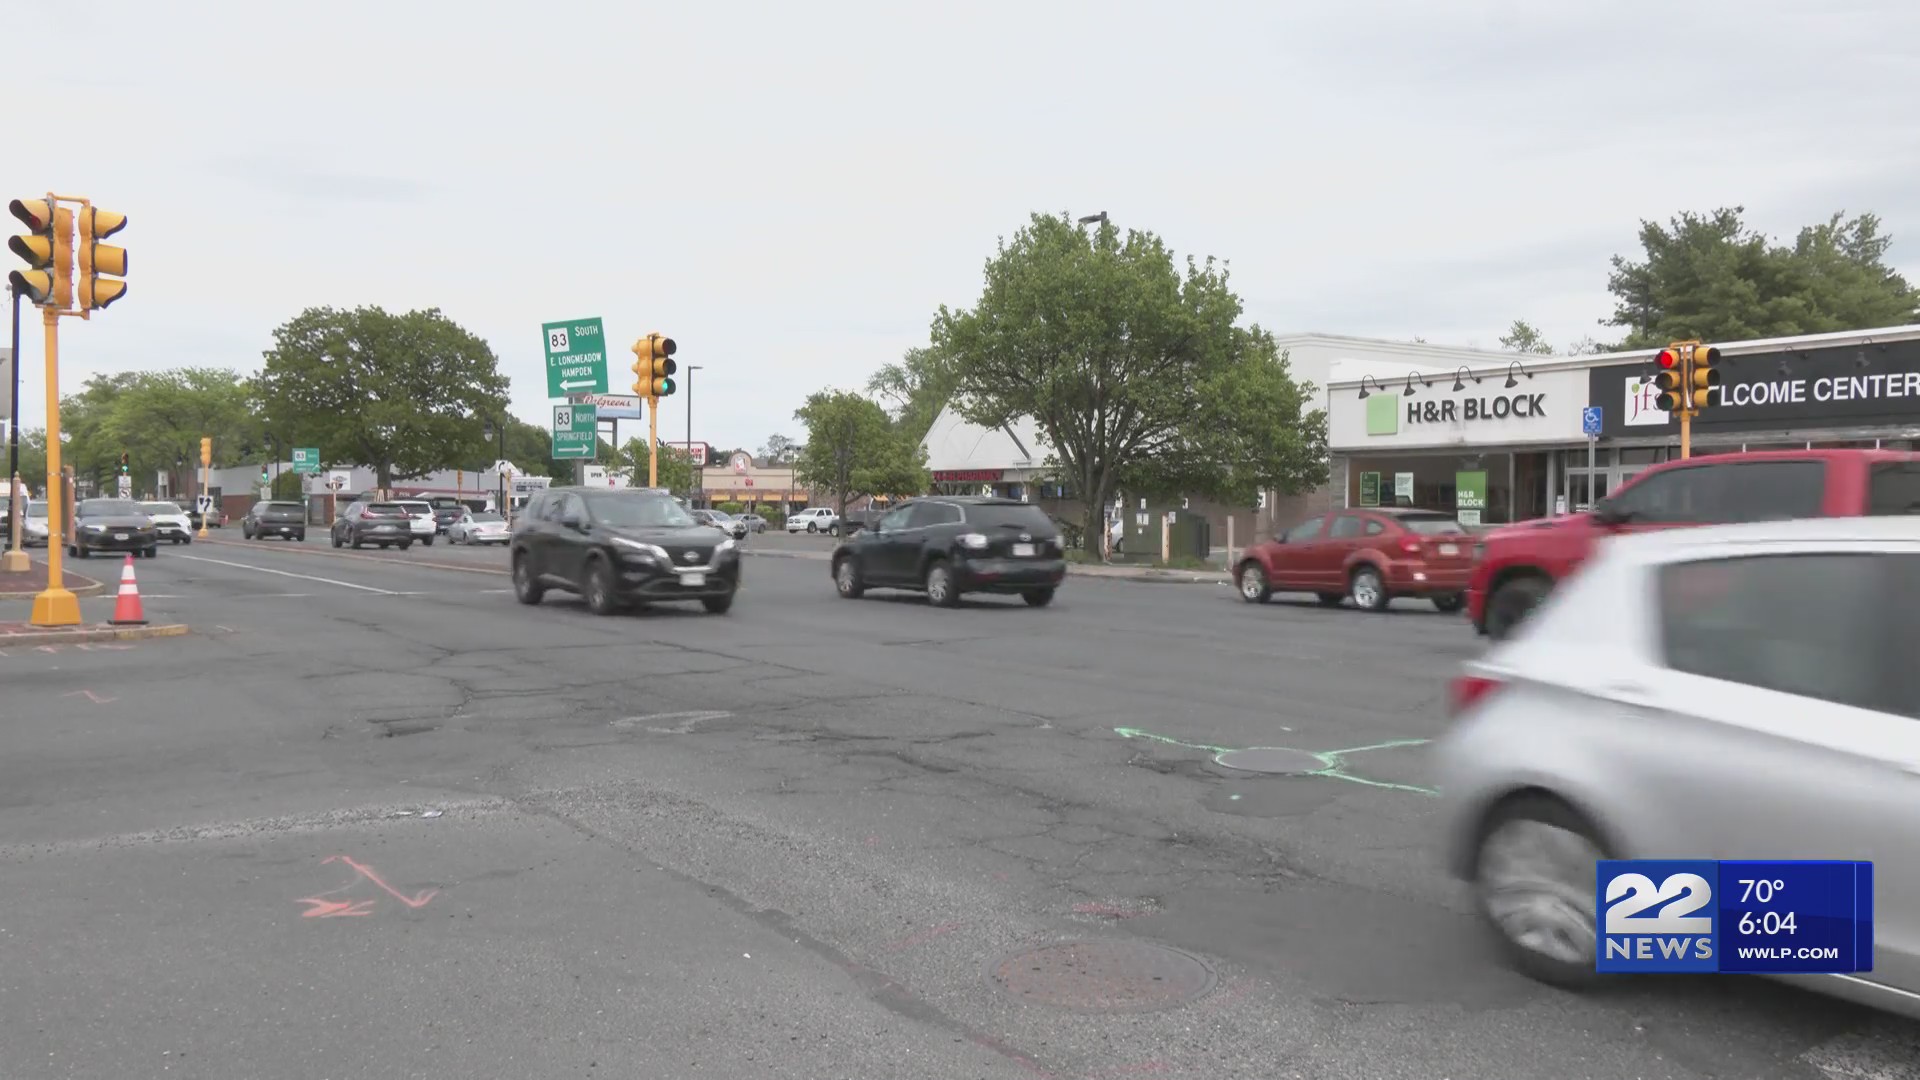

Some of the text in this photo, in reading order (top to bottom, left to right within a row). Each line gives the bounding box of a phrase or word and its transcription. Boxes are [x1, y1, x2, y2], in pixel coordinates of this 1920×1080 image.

[551, 325, 599, 347] 83 SOUTH
[558, 352, 602, 366] LONGMEADOW
[561, 366, 593, 378] HAMPDEN
[1686, 372, 1920, 407] LCOME CENTER
[1407, 393, 1547, 424] H&R BLOCK
[557, 412, 595, 425] 83 NORTH
[556, 431, 593, 442] SPRINGFIELD
[1458, 490, 1474, 498] H&R
[1458, 499, 1484, 507] BLOCK
